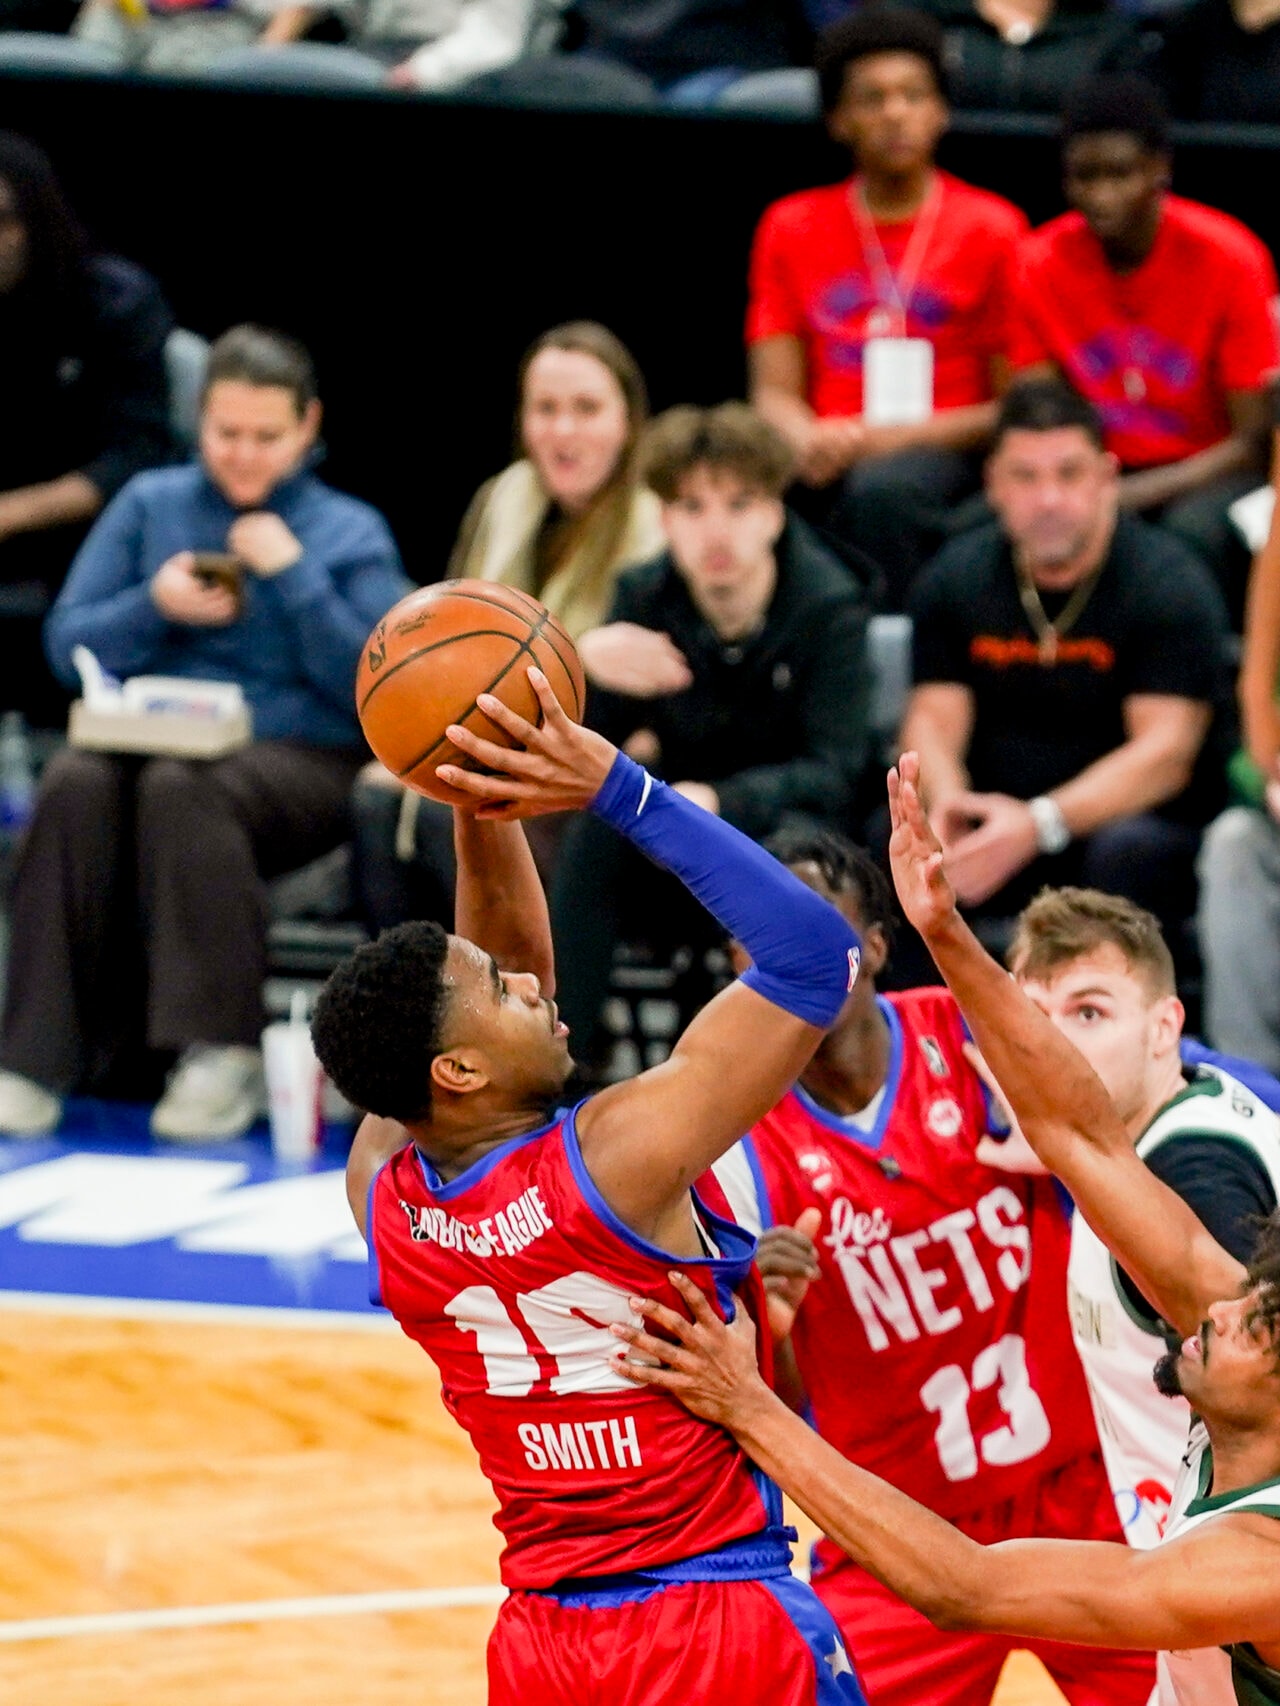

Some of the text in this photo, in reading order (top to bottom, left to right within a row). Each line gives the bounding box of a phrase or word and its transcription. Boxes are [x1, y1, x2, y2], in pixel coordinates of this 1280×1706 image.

[835, 1186, 1032, 1353] NETS
[517, 1416, 642, 1470] SMITH
[919, 1333, 1051, 1482] 13
